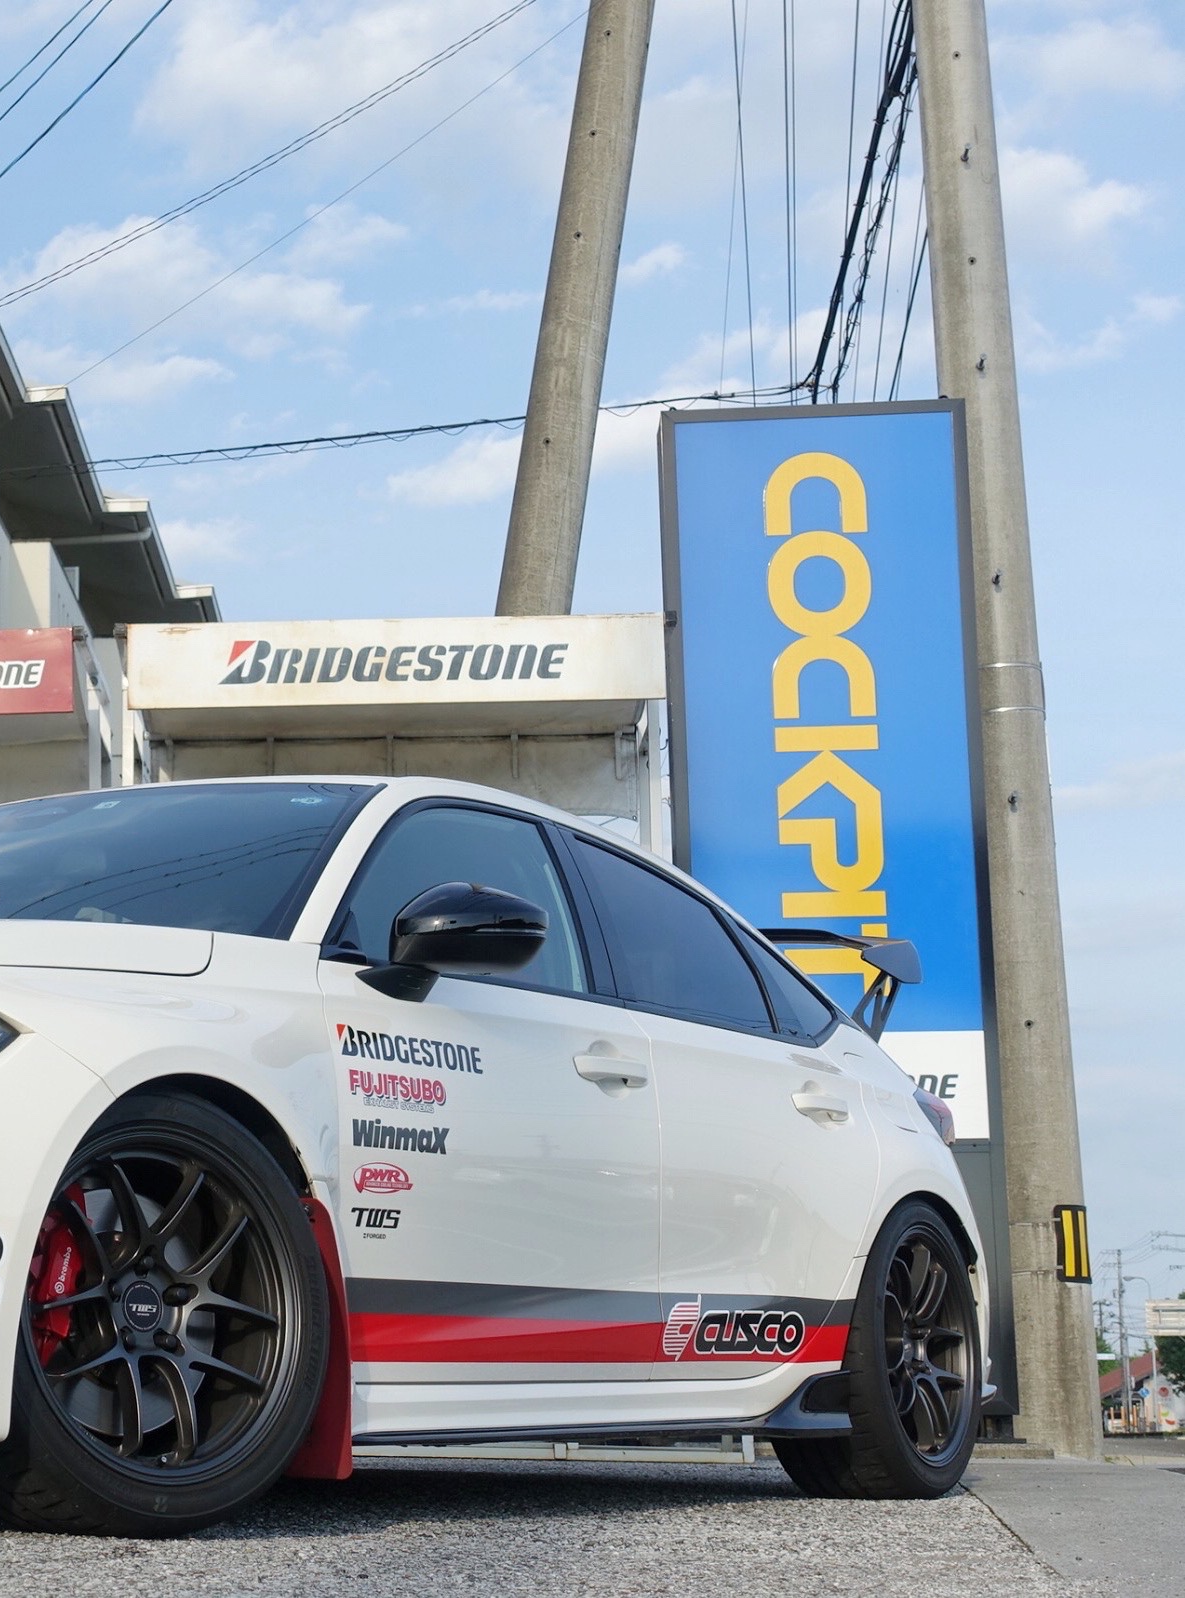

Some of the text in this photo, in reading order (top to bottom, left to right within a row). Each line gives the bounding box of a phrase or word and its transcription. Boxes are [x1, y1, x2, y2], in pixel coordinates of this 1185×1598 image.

[218, 640, 569, 685] BRIDGESTONE
[763, 452, 889, 997] COCKPIT
[336, 1023, 484, 1075] BRIDGESTONE
[348, 1069, 447, 1106] FUJITSUBO
[351, 1206, 401, 1229] TWS
[58, 1246, 72, 1283] brembo
[129, 1303, 157, 1312] TWS
[694, 1310, 806, 1356] CUSCO
